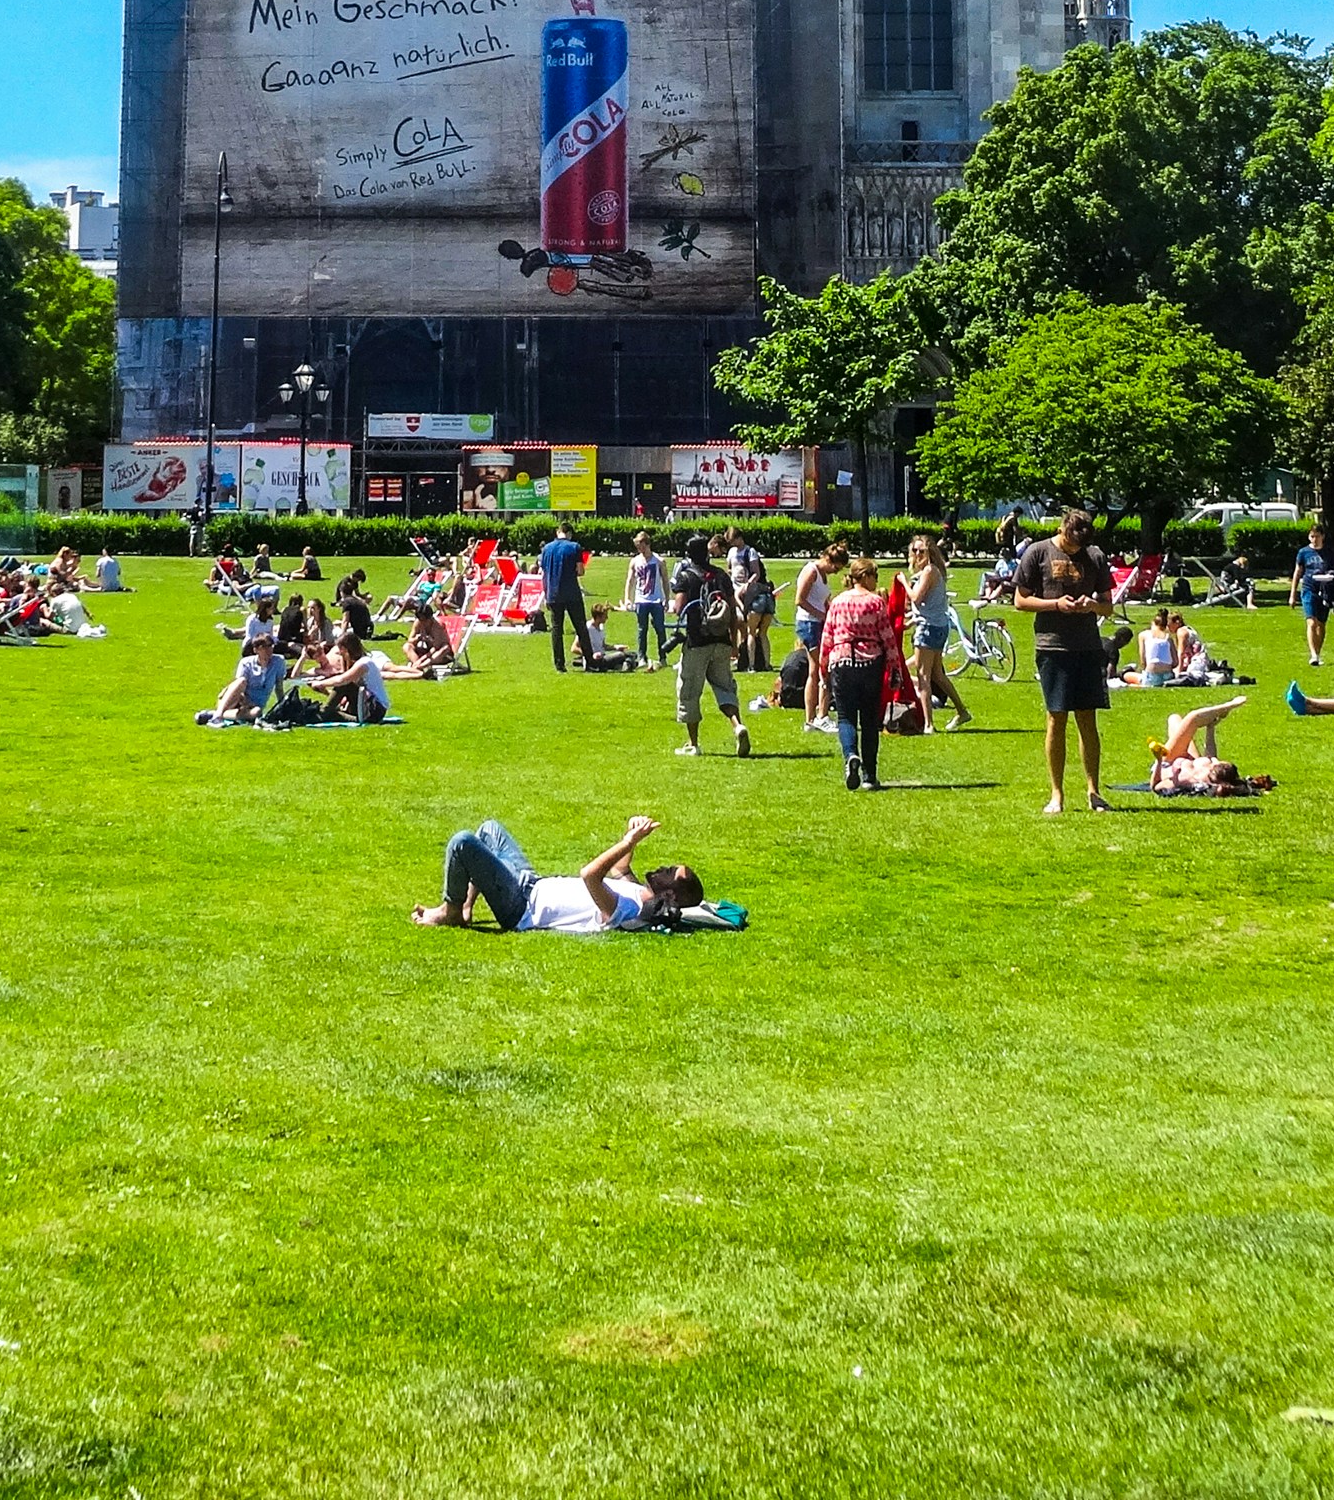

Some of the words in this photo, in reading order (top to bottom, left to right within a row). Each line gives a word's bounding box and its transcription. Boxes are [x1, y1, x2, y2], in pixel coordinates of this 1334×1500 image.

[261, 60, 380, 92] Gaaaanz
[393, 25, 510, 68] natürlich.
[546, 53, 566, 67] Red
[568, 53, 594, 67] Bull
[641, 100, 661, 109] ALL
[558, 97, 624, 158] COLA
[335, 144, 388, 169] Simply
[333, 184, 357, 199] Das
[359, 177, 388, 198] Cola
[410, 171, 435, 190] Red
[271, 470, 321, 487] GESCHACK
[676, 484, 698, 497] Vive
[699, 484, 710, 497] la
[711, 484, 752, 497] Chance!
